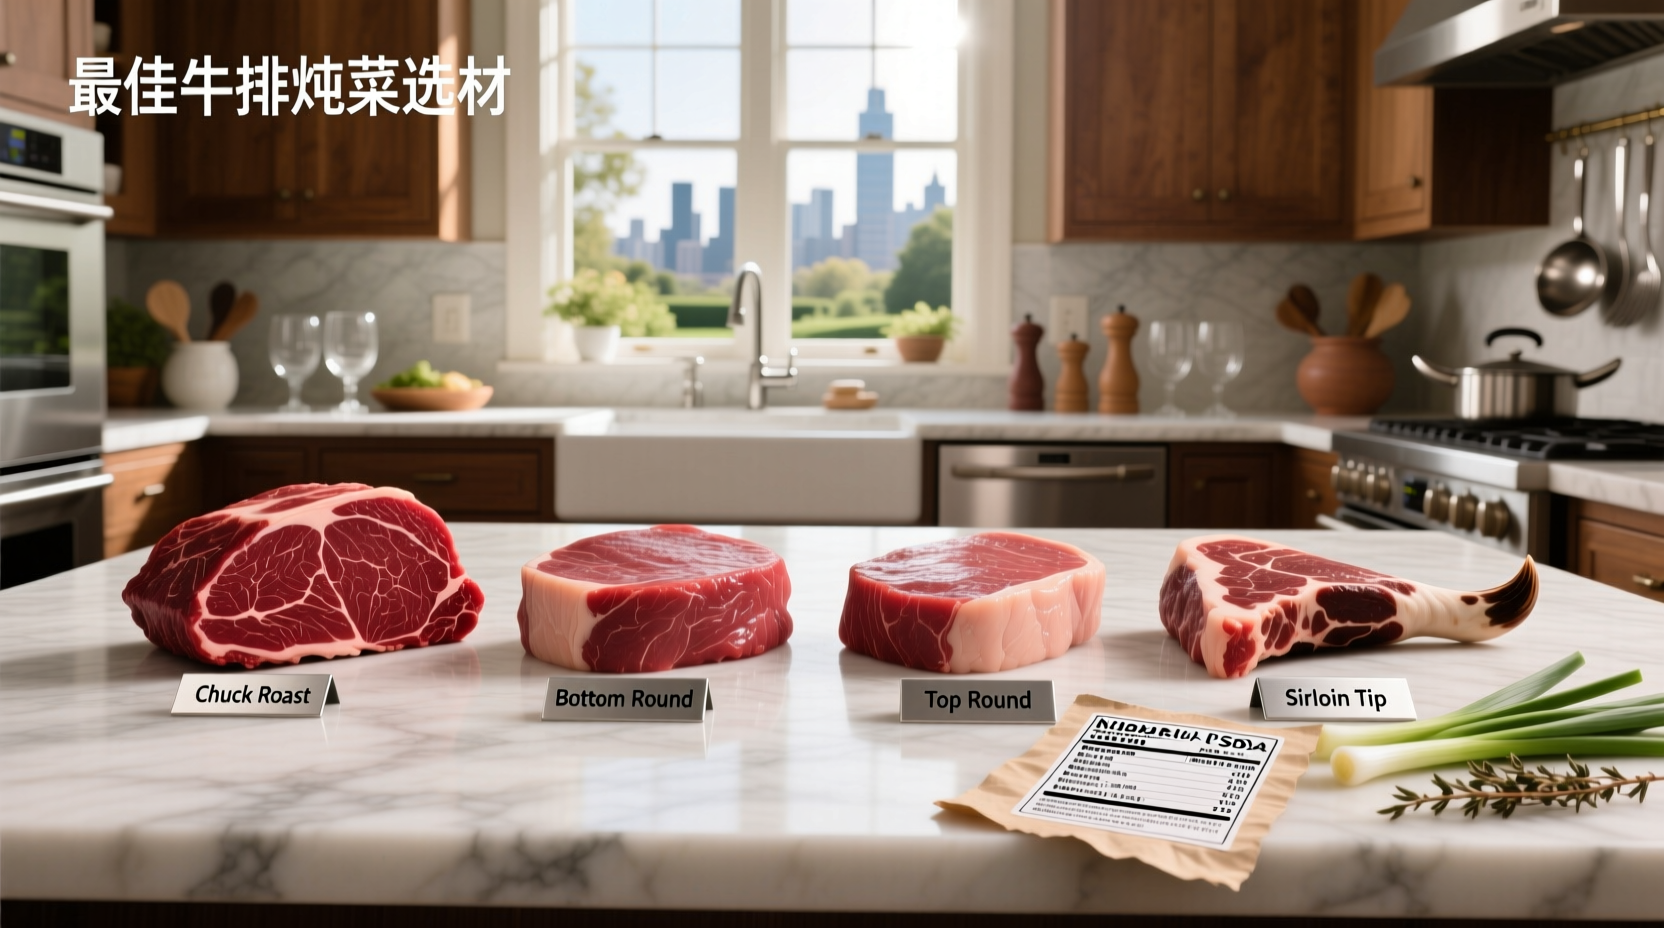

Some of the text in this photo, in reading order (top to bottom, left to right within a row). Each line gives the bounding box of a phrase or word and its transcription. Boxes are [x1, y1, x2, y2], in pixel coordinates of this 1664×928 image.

[195, 684, 312, 705] Chuck Roast
[555, 688, 694, 709] Bottom Round
[924, 689, 1032, 715] Top Round
[1285, 688, 1387, 712] Sirloin Tip
